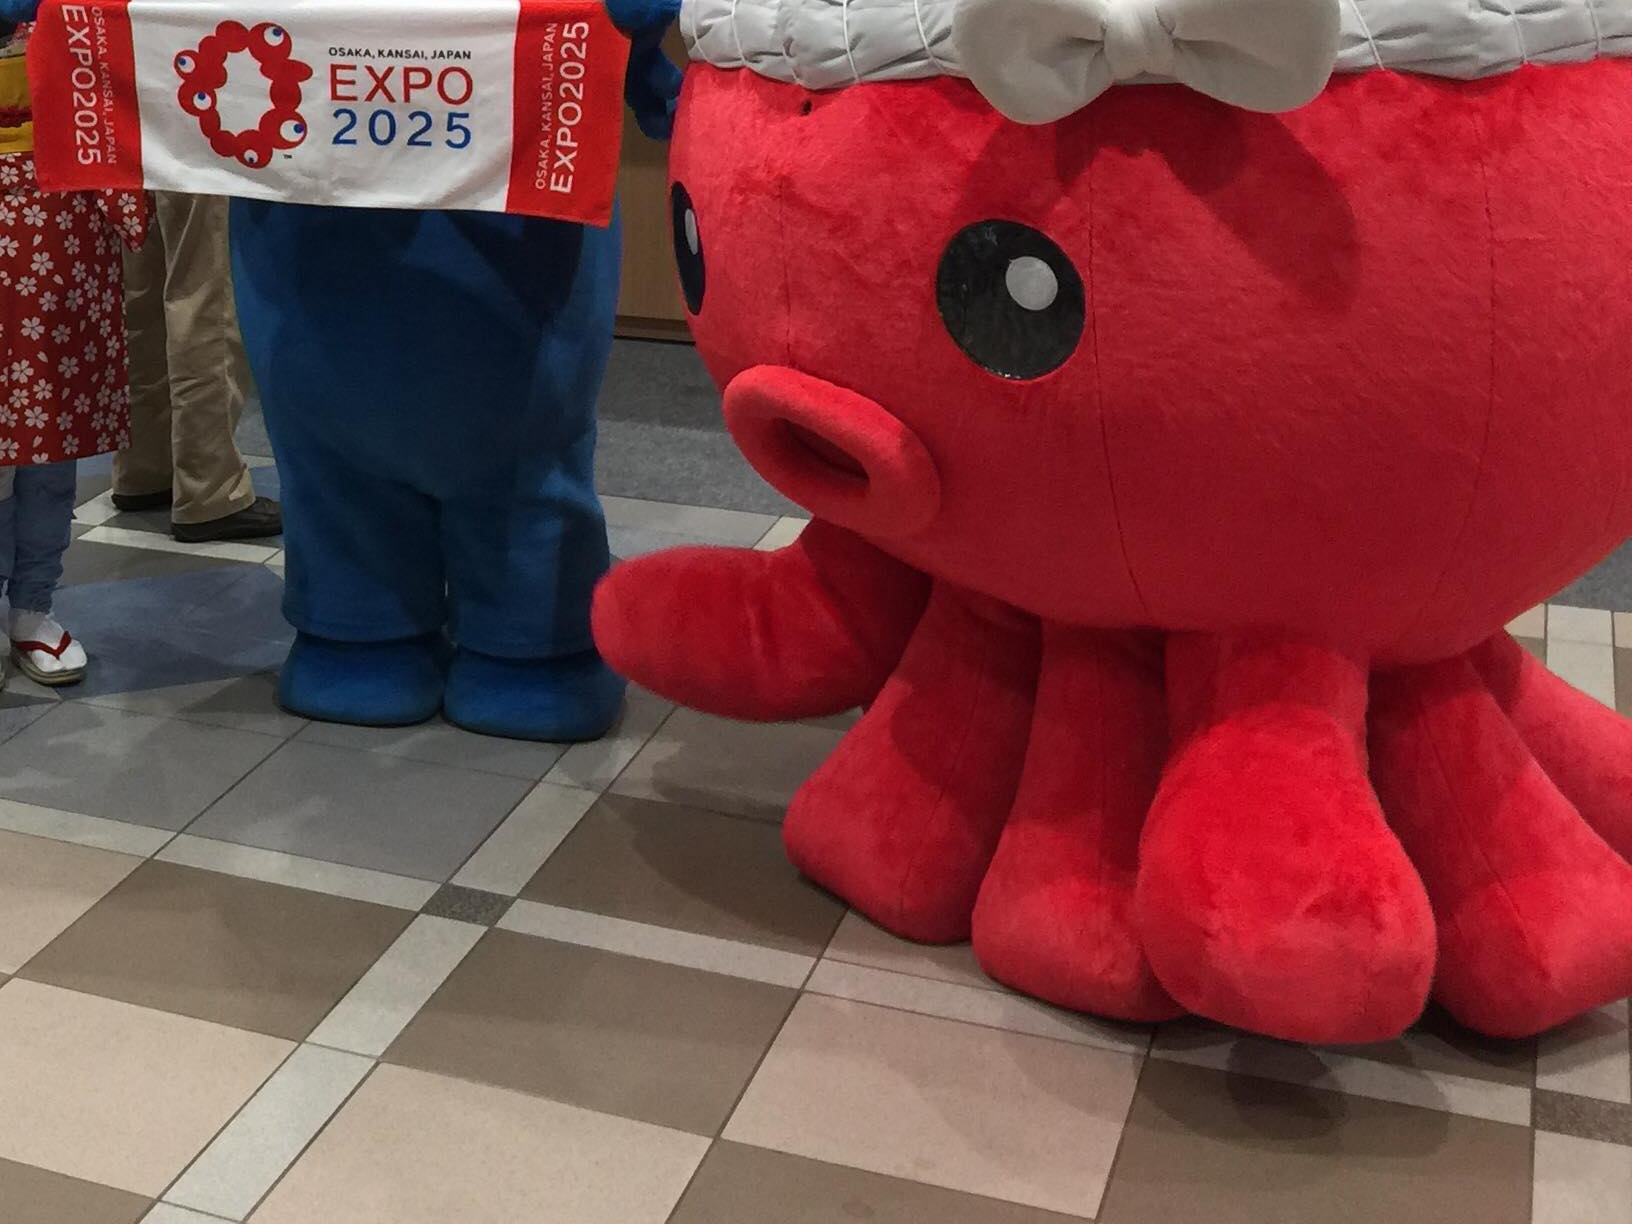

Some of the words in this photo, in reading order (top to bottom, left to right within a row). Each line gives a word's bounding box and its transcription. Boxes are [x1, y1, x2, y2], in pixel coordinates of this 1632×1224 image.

[328, 47, 375, 60] OSAKA,
[378, 49, 428, 61] KANSAI,
[431, 50, 472, 60] JAPAN
[542, 23, 558, 69] JAPAN
[62, 4, 102, 165] EXPO2025
[329, 63, 474, 106] EXPO
[550, 21, 590, 194] EXPO2025
[103, 119, 117, 165] JAPAN
[331, 108, 472, 150] 2025
